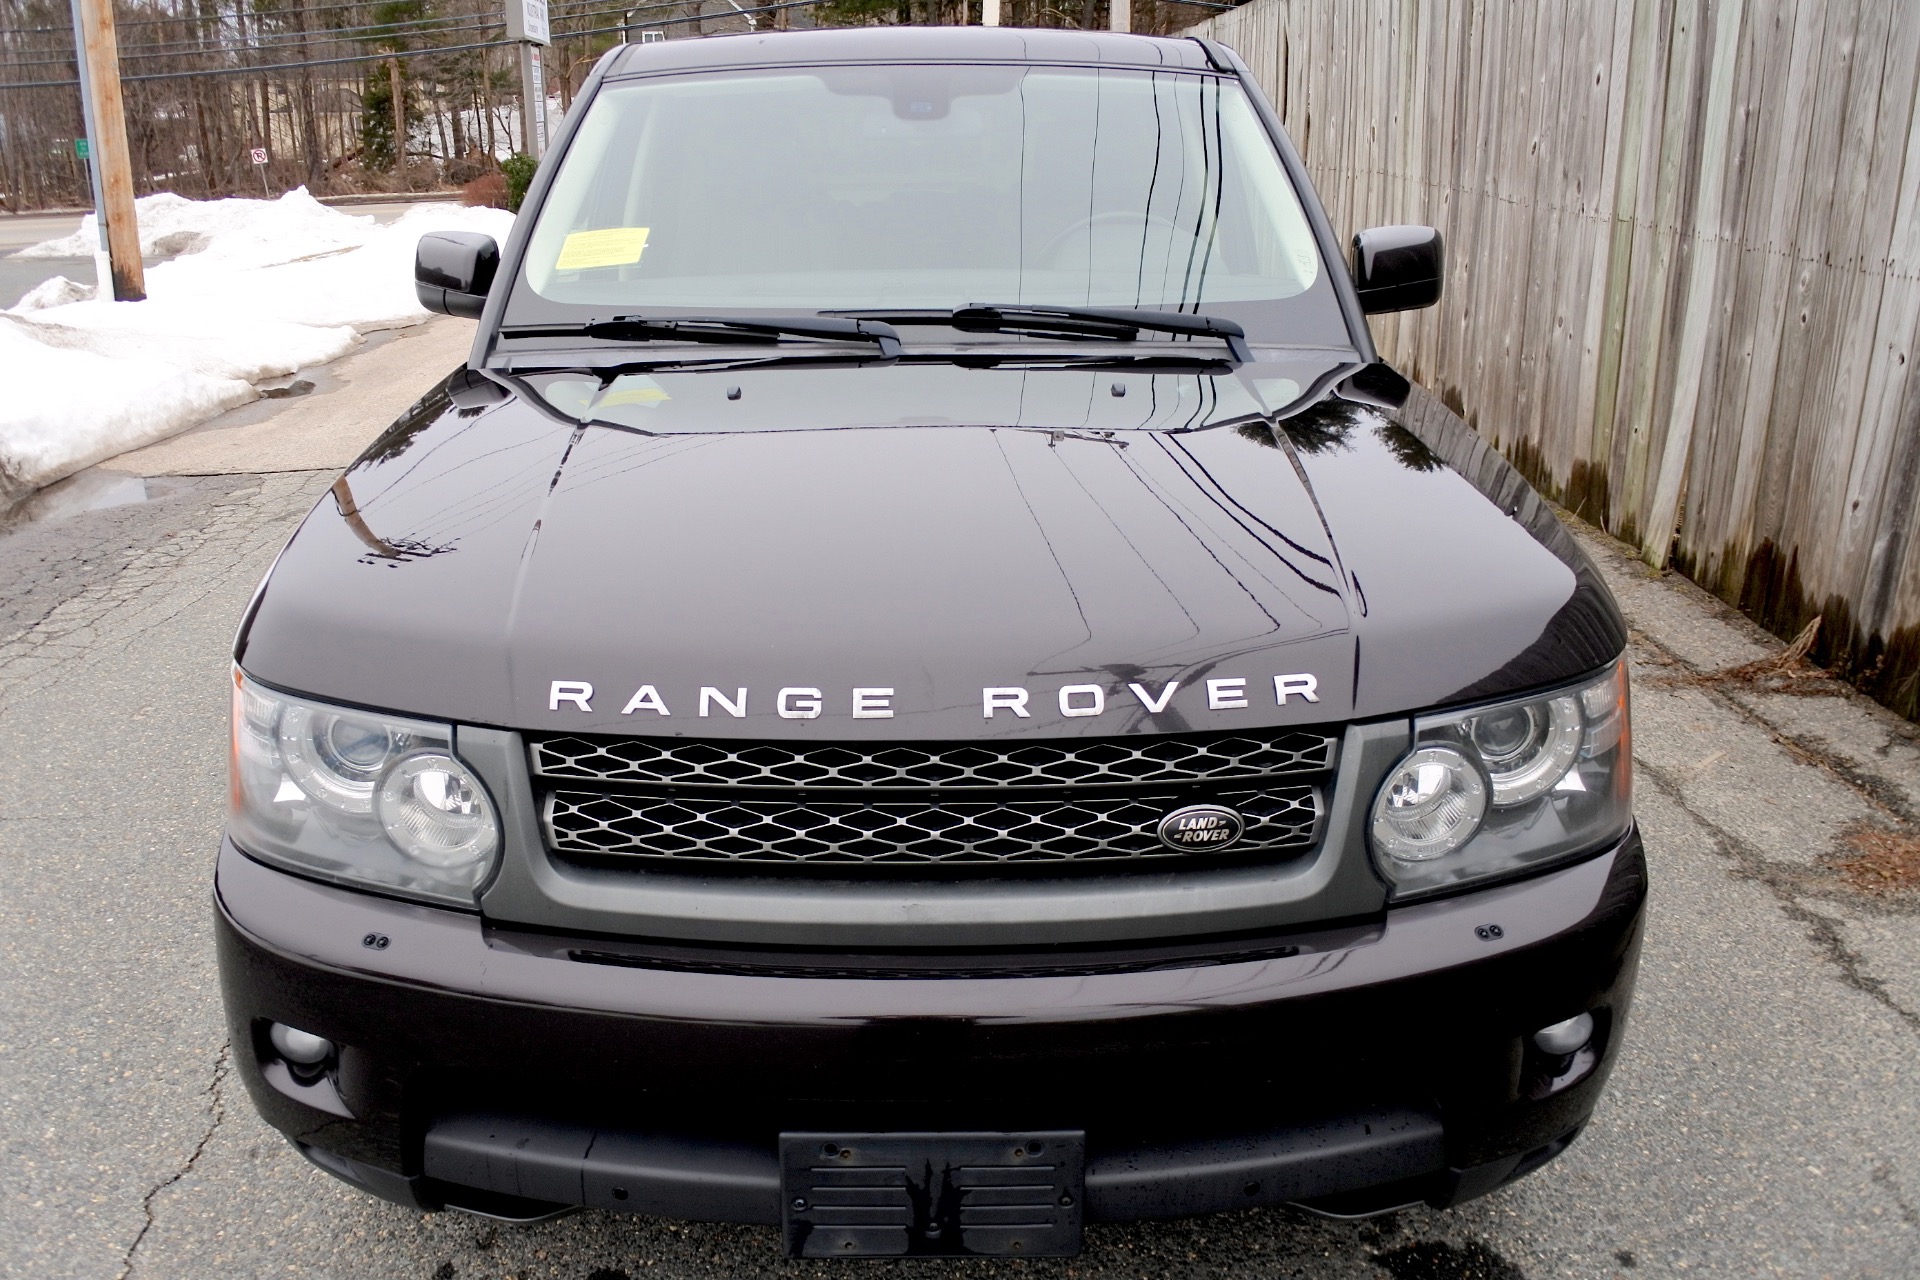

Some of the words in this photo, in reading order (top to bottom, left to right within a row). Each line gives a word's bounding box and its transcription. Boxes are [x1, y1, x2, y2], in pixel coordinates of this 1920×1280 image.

[549, 680, 894, 719] RANGE
[982, 673, 1320, 719] ROVER
[1178, 817, 1218, 830] LAND
[1182, 829, 1229, 842] ROVER
